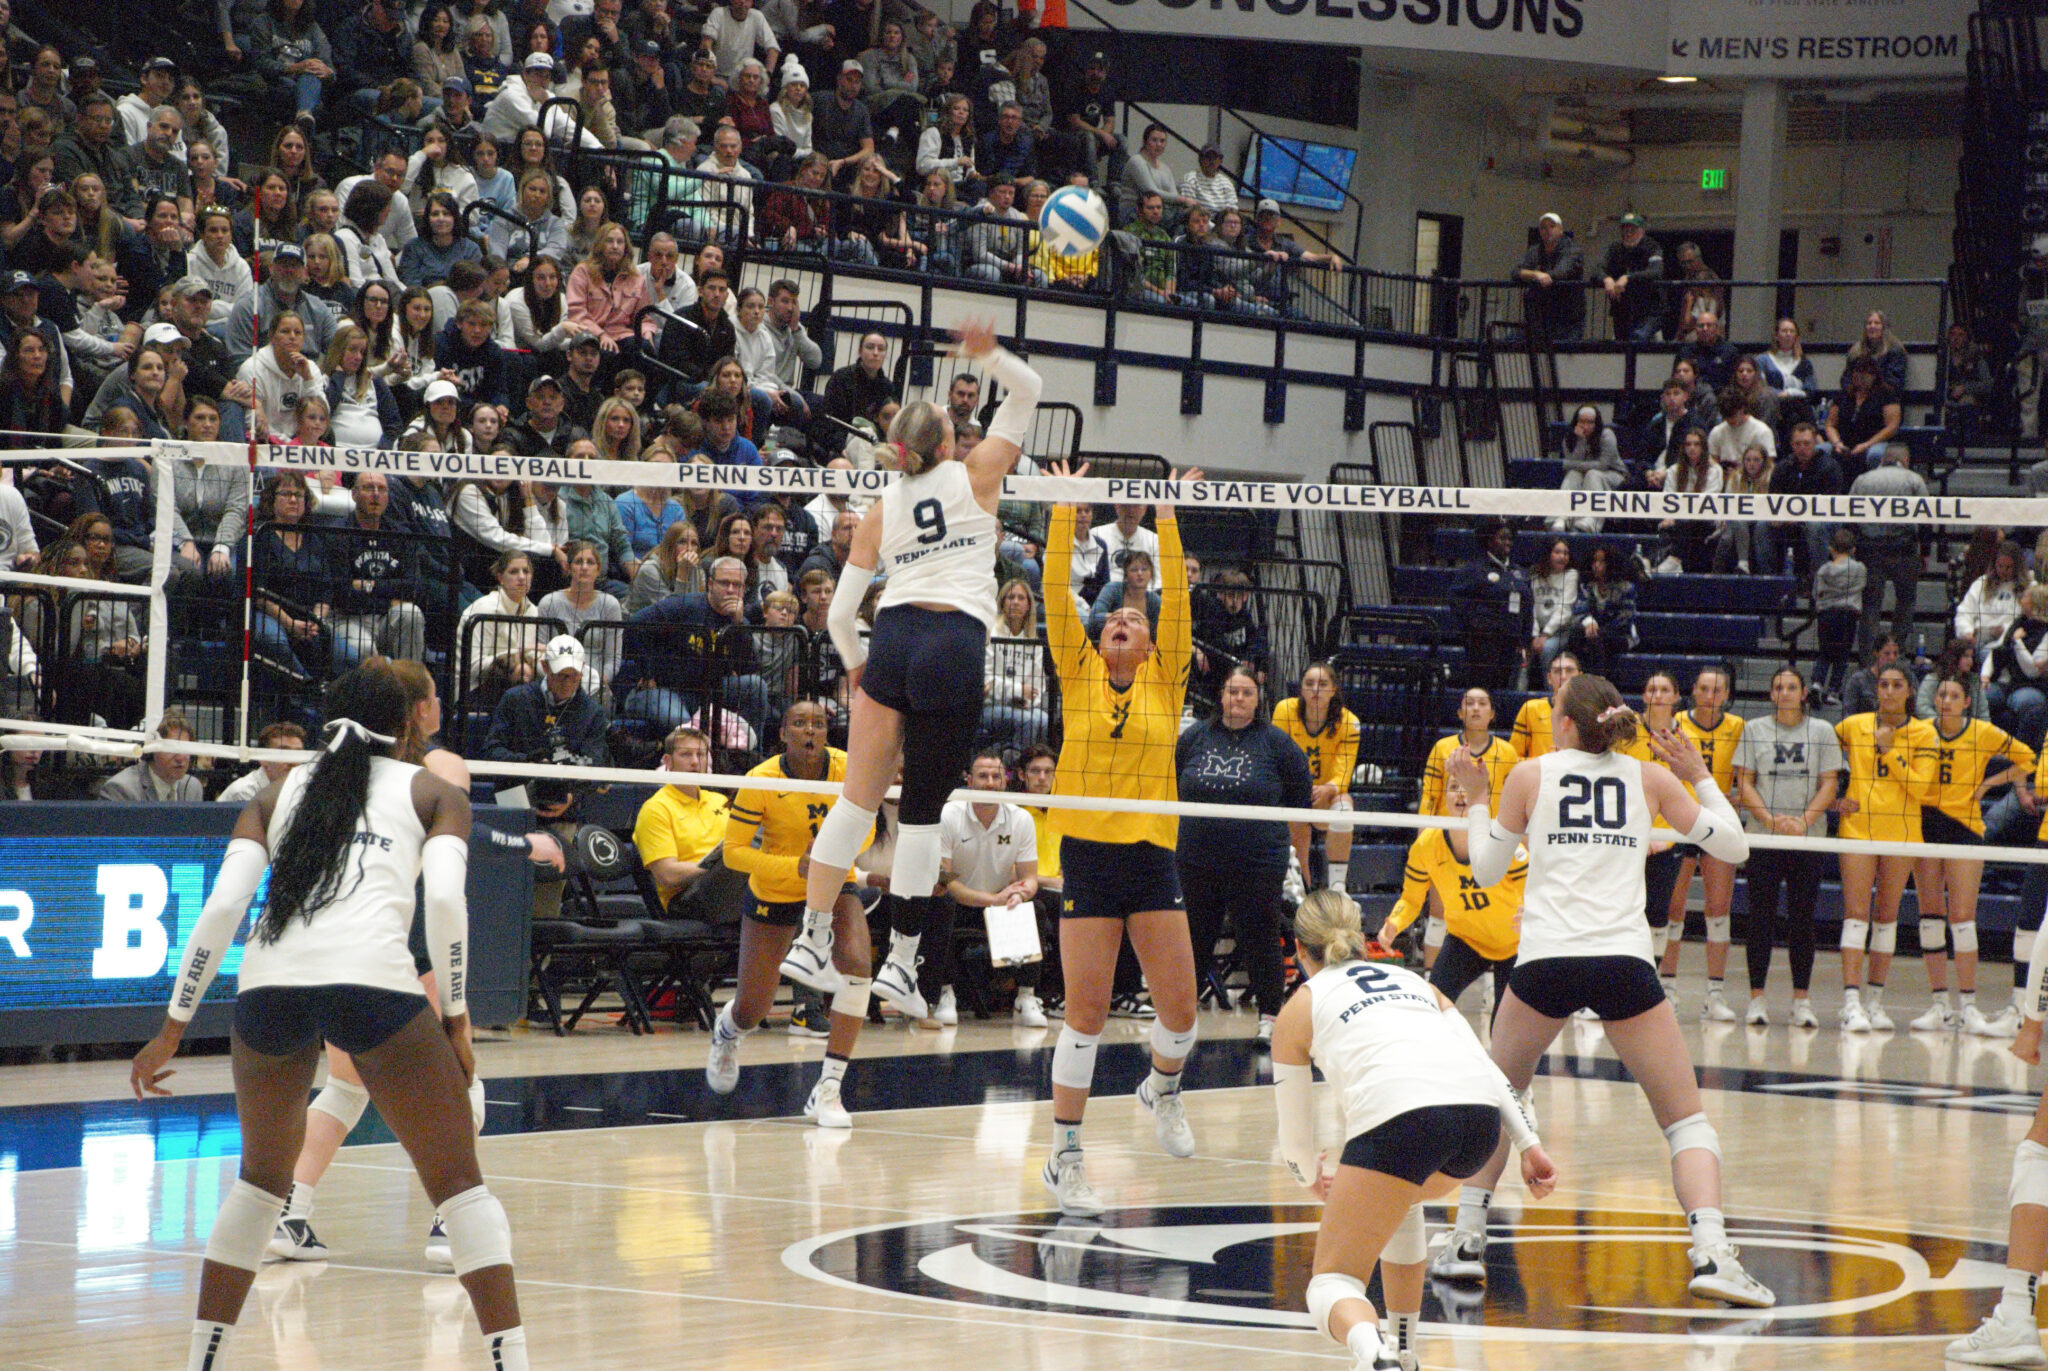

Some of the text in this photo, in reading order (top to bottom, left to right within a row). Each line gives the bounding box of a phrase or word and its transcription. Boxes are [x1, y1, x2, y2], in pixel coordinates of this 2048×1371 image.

[1699, 34, 1959, 60] MEN'S RESTROOM
[1701, 169, 1725, 190] EXIT
[269, 445, 593, 480] PENN STATE VOLLEYBALL
[679, 464, 748, 485] PENN
[757, 467, 837, 489] STATE
[1107, 479, 1471, 509] PENN STATE VOLLEYBALL
[1570, 491, 1973, 520] PENN STATE VOLLEYBALL
[913, 497, 947, 545] 9
[558, 645, 573, 655] M
[1773, 743, 1805, 763] M
[1939, 749, 1955, 761] M
[1202, 754, 1245, 779] M
[1939, 763, 1952, 785] 6
[806, 802, 829, 819] M
[1559, 774, 1626, 829] 20
[998, 834, 1012, 846] M
[1547, 833, 1638, 848] PENN STATE
[1458, 874, 1484, 890] M
[1459, 891, 1491, 911] 10
[177, 946, 212, 1009] WE ARE
[449, 940, 464, 1003] WE ARE
[1345, 965, 1403, 994] 2
[1339, 994, 1387, 1024] PENN
